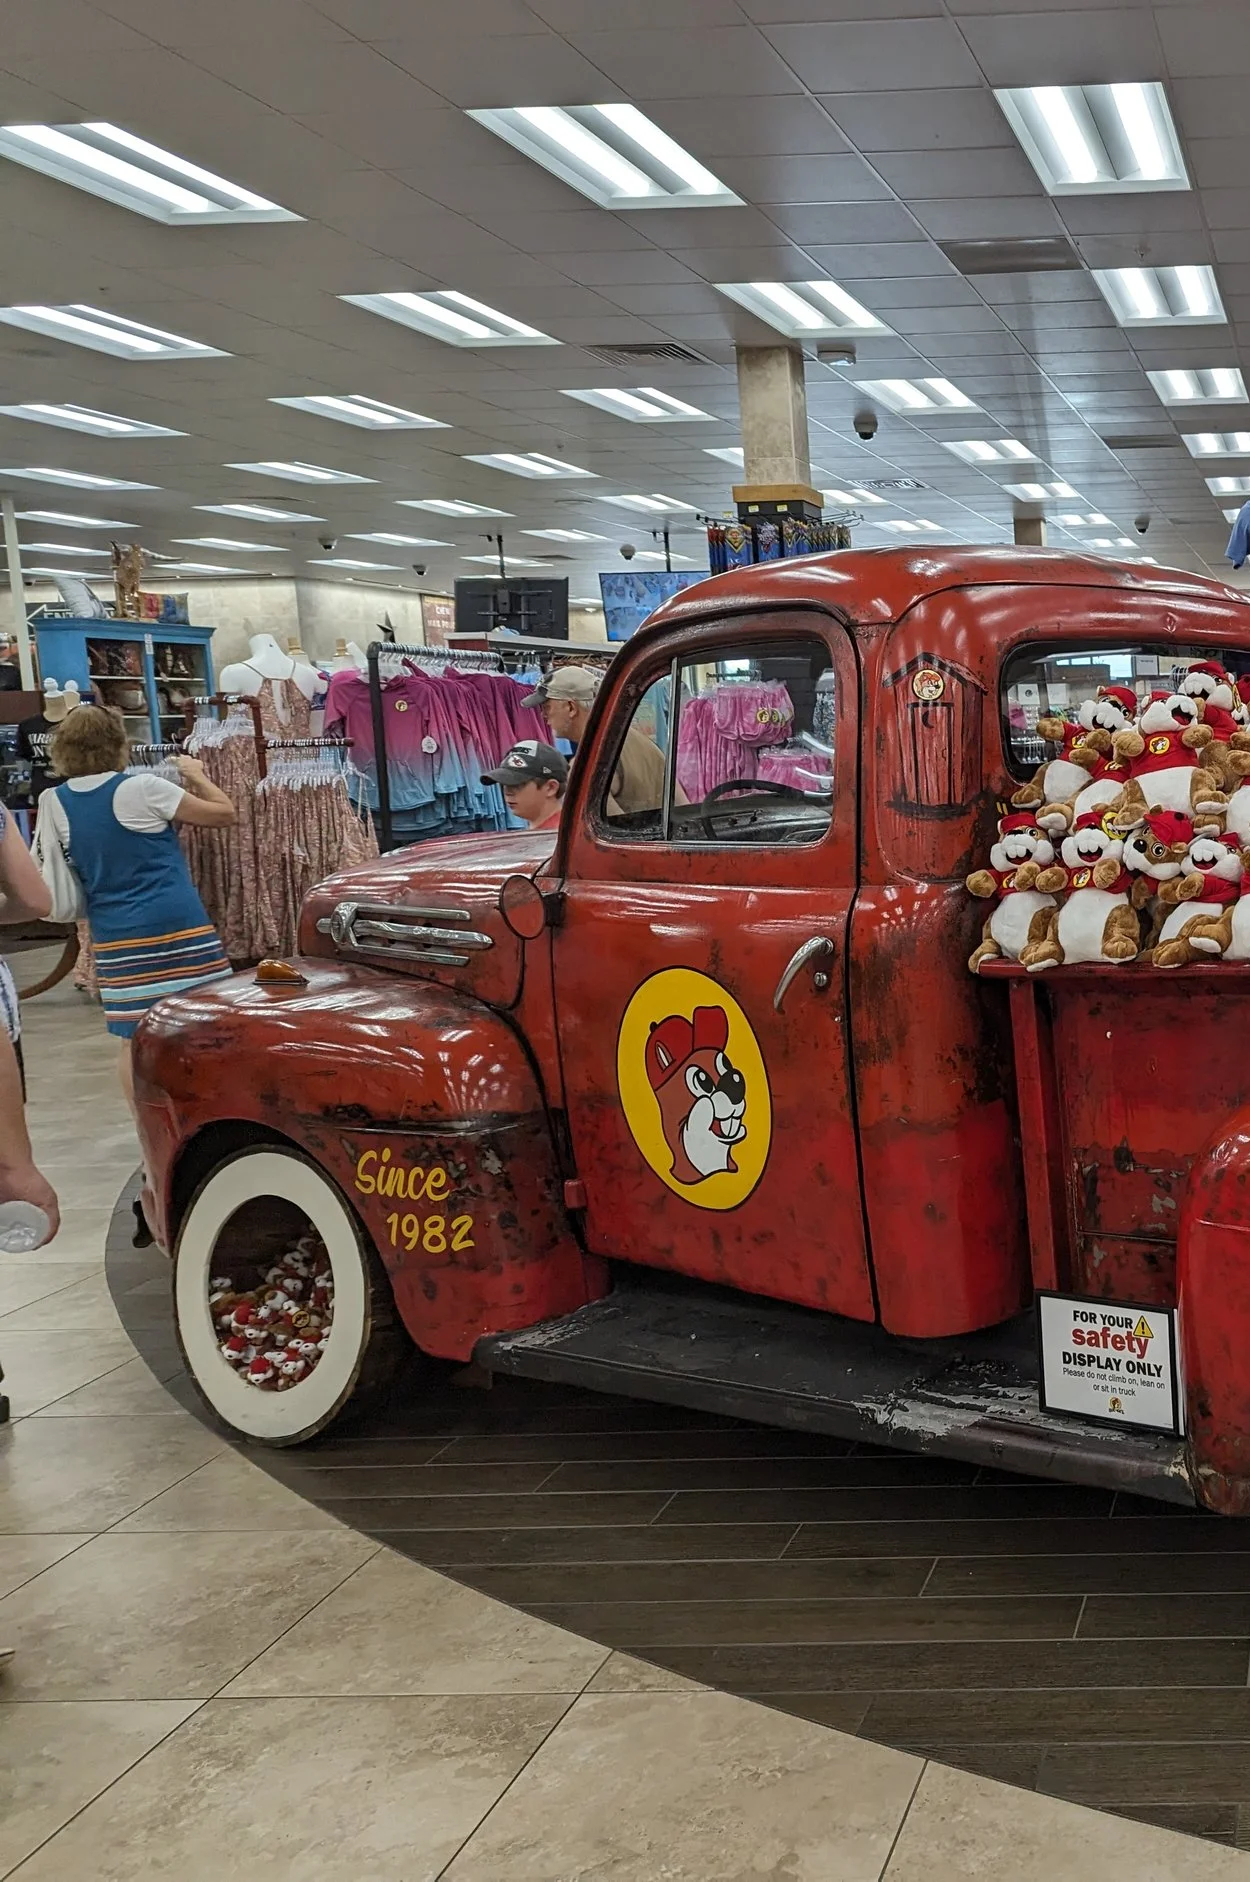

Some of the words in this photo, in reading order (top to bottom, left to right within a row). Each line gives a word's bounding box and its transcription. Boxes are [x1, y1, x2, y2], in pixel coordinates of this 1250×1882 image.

[354, 1147, 450, 1202] Since
[386, 1212, 475, 1254] 1982
[1072, 1310, 1097, 1324] FOR
[1100, 1313, 1134, 1329] YOUR
[1071, 1326, 1150, 1360] safety
[1062, 1351, 1123, 1372] DISPLAY
[1125, 1360, 1163, 1378] ONLY
[1062, 1367, 1086, 1378] Please
[1086, 1370, 1096, 1379] do
[1096, 1371, 1108, 1381] not
[1108, 1373, 1127, 1384] climb
[1128, 1376, 1139, 1387] on,
[1140, 1379, 1155, 1388] lean
[1155, 1381, 1166, 1389] on
[1100, 1384, 1110, 1393] sit
[1110, 1385, 1118, 1394] in
[1118, 1386, 1136, 1397] truck
